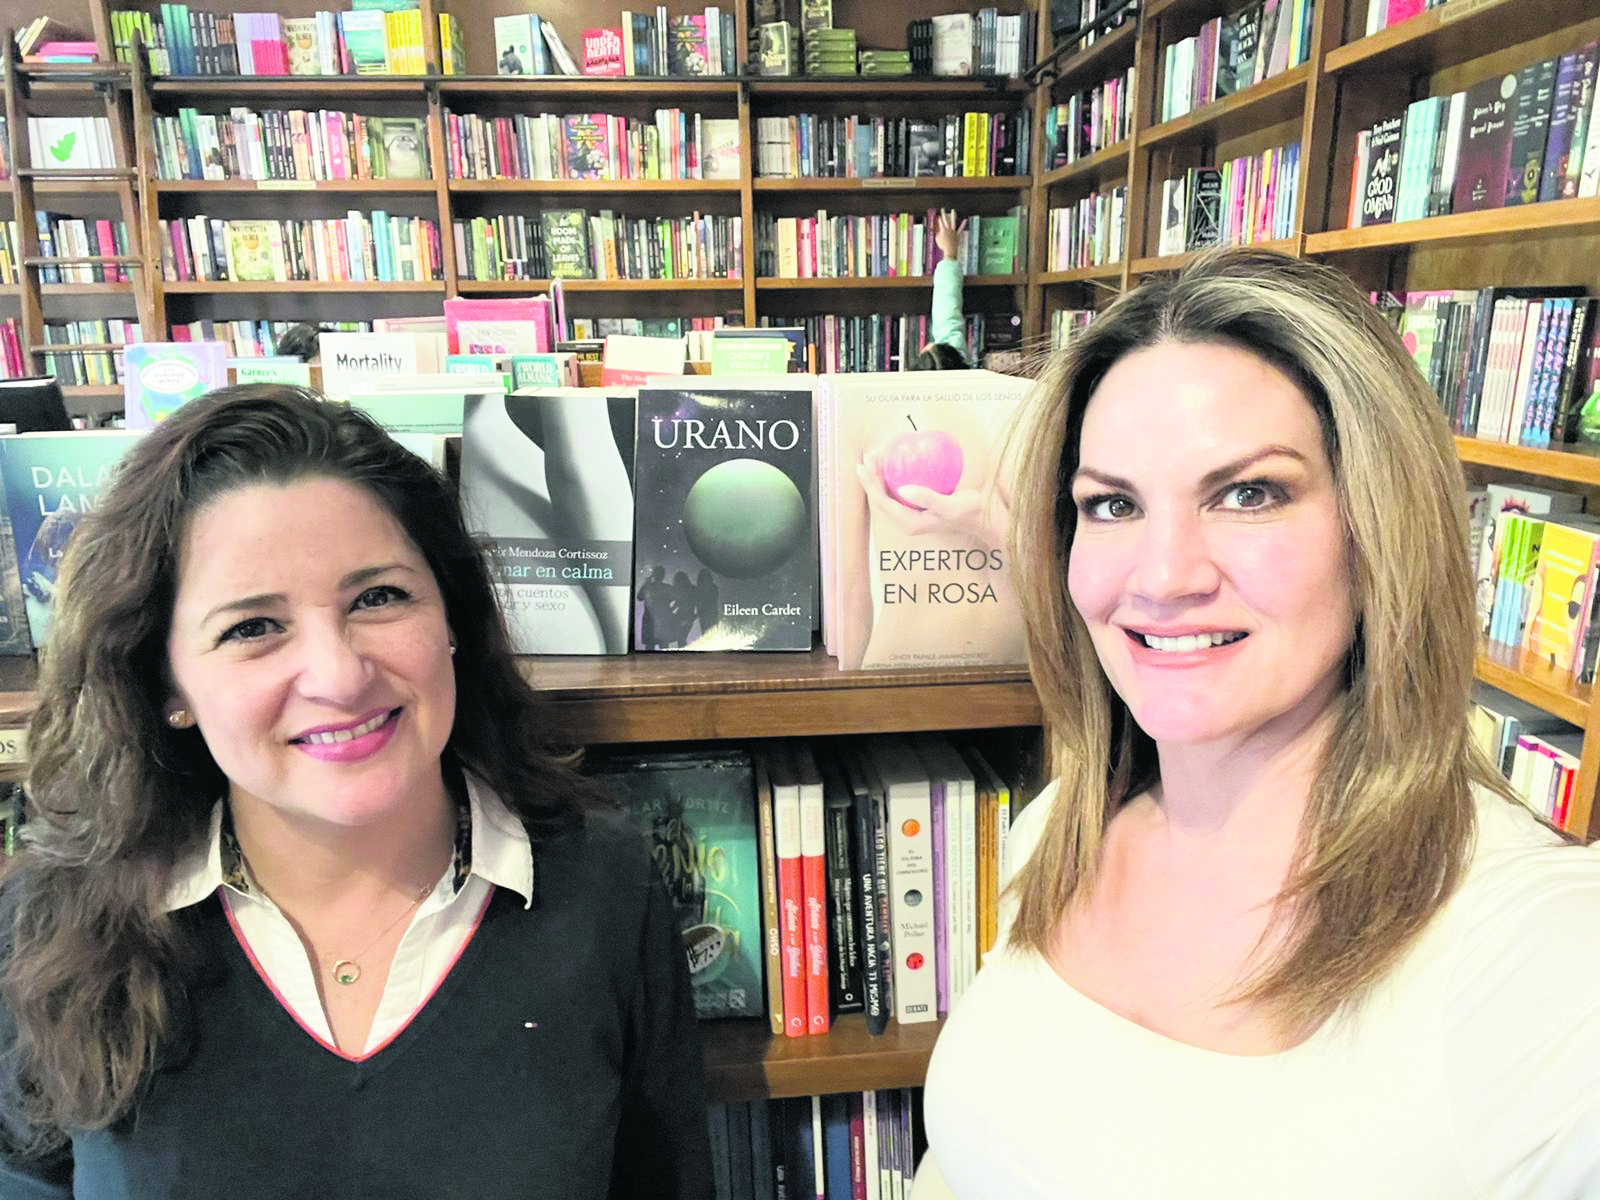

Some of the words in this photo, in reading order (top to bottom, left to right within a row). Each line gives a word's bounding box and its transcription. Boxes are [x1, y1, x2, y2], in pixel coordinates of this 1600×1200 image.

[336, 353, 402, 374] Mortality
[651, 417, 800, 450] URANO
[508, 546, 556, 558] Mendoza
[558, 547, 608, 560] Cortissoz
[880, 549, 1003, 571] EXPERTOS
[535, 565, 556, 579] en
[561, 563, 613, 580] calma
[517, 587, 569, 600] cuentos
[884, 583, 917, 604] EN
[928, 583, 998, 604] ROSA
[534, 601, 566, 612] sexo
[723, 603, 758, 616] Eileen
[761, 603, 801, 617] Cardet
[862, 873, 872, 893] UNA
[864, 894, 875, 941] AVENTURA
[900, 921, 929, 930] Michael
[867, 943, 877, 968] HACIA
[869, 972, 877, 981] TI
